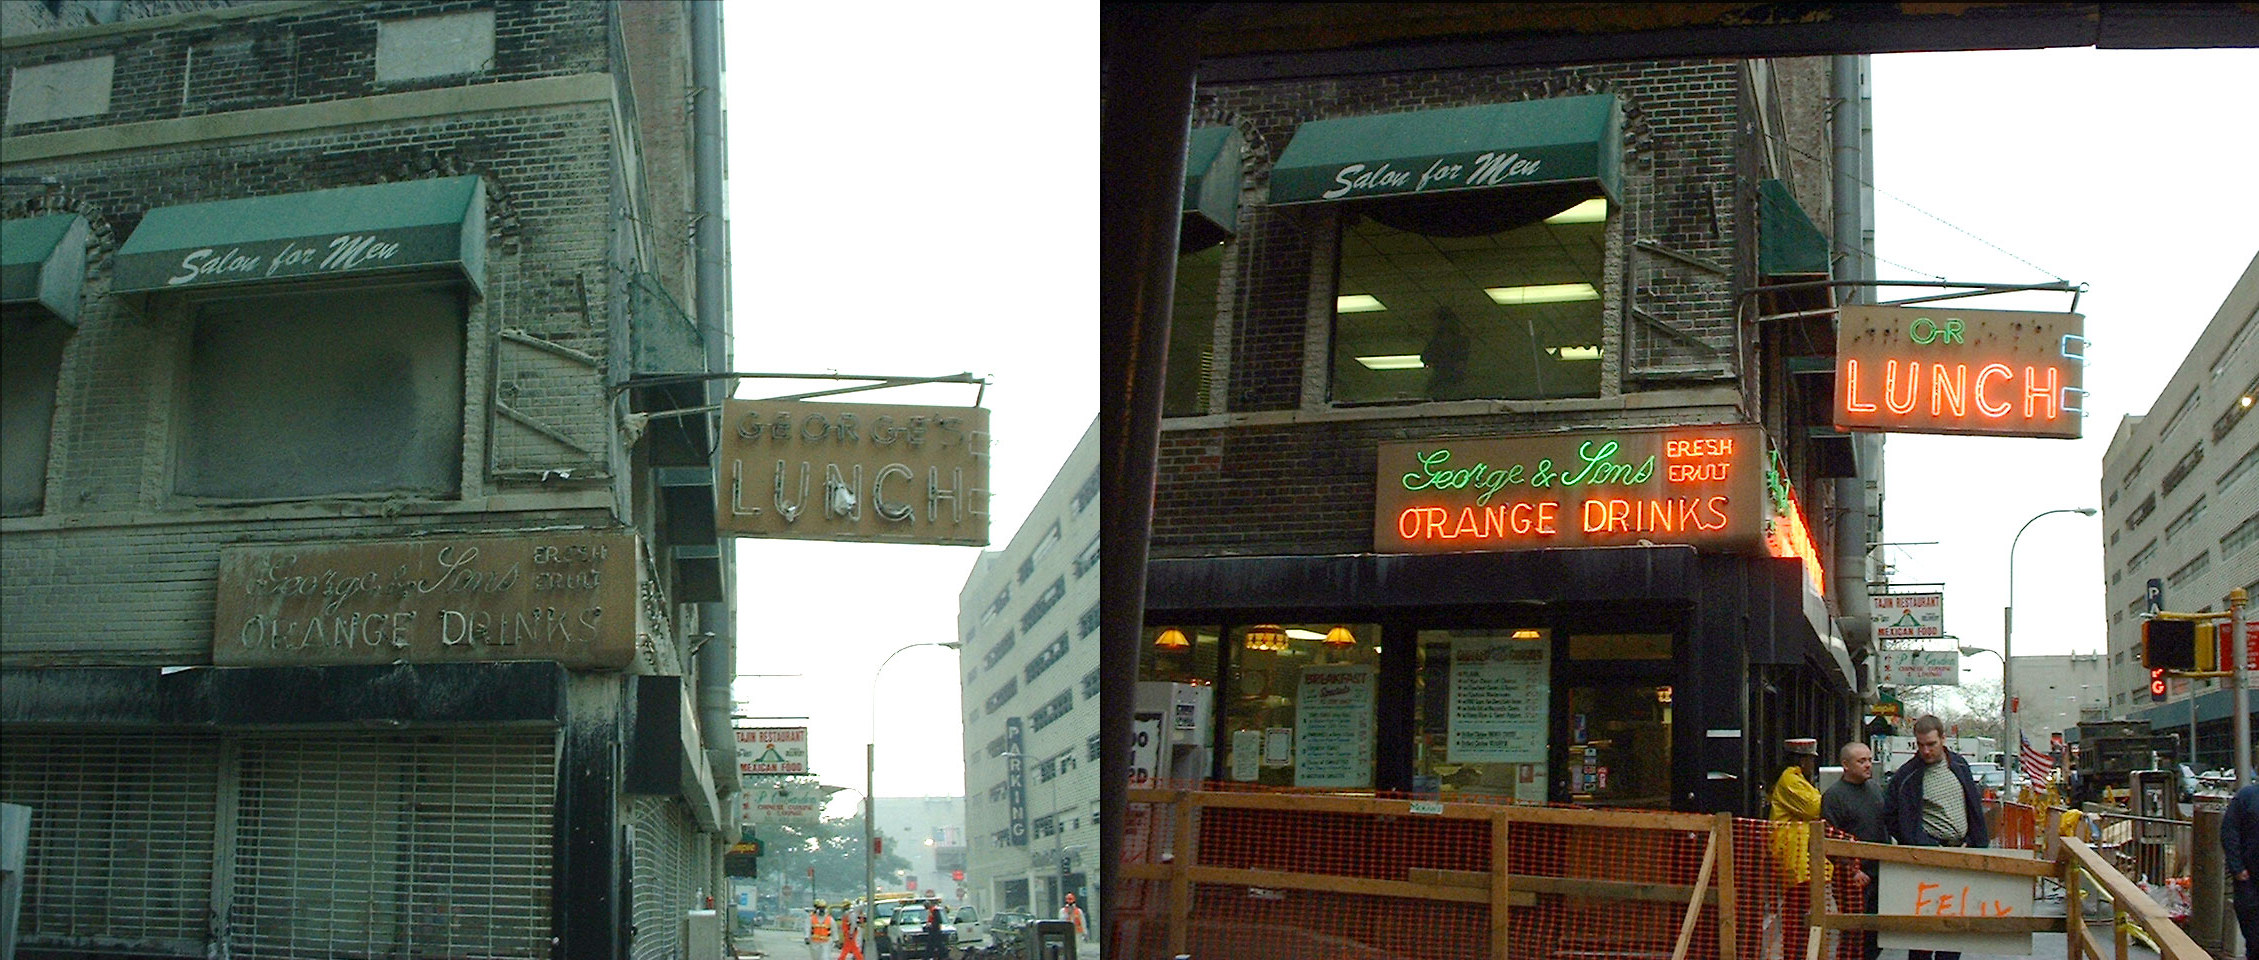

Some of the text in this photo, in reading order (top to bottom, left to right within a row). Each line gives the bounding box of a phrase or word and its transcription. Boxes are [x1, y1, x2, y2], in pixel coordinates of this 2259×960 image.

[1322, 152, 1542, 200] Salon for Men
[168, 235, 400, 285] Salon for Men
[1847, 358, 2058, 419] LUNCH
[736, 411, 964, 448] GEORGE'S
[732, 458, 963, 524] LUNCH
[1401, 439, 1657, 508] George & Sons
[1398, 496, 1730, 540] ORANGE DRINKS
[246, 554, 382, 615] George
[1896, 596, 1940, 609] RESTAURANT
[241, 606, 602, 650] ORANGE DRINKS
[1877, 627, 1938, 636] MEXICAN FOOD
[759, 730, 805, 743] RESTAURANT
[740, 762, 803, 772] MEXICAN FOOD
[1008, 726, 1027, 837] PARKING
